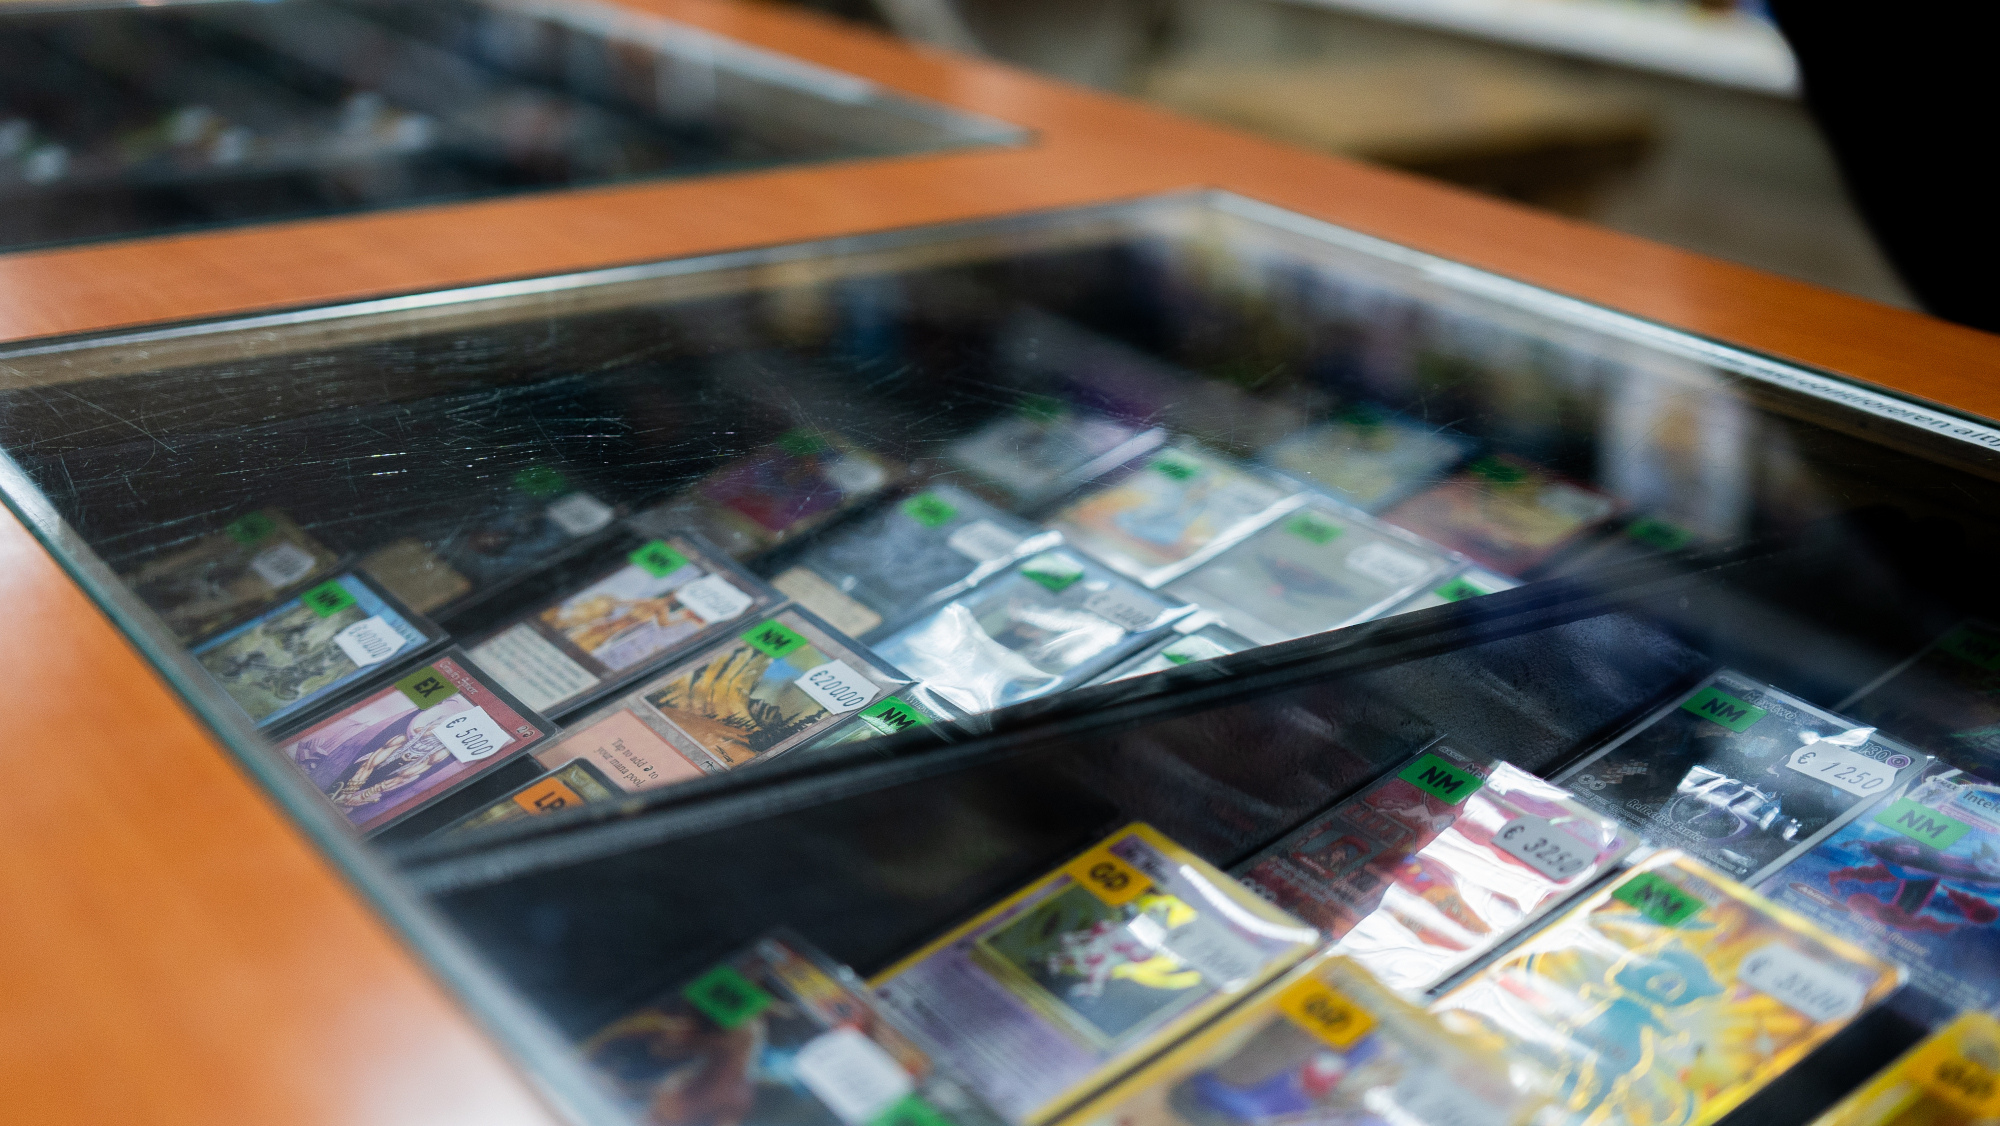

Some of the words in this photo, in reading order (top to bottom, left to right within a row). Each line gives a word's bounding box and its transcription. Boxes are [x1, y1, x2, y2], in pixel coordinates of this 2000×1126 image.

[756, 627, 793, 651] NM
[413, 676, 445, 699] EX
[1700, 697, 1748, 723] NM
[1743, 689, 1797, 720] Mewtwo
[446, 716, 467, 729] €
[876, 705, 917, 733] NM
[593, 746, 614, 760] your
[609, 758, 630, 775] mana
[612, 737, 627, 752] Tap
[622, 749, 634, 758] to
[629, 756, 649, 768] add
[648, 771, 659, 780] to
[1797, 751, 1817, 765] €
[1417, 764, 1465, 795] NM
[1503, 825, 1525, 840] €
[1896, 809, 1949, 839] NM
[1088, 861, 1131, 892] GD
[1633, 882, 1684, 917] NM
